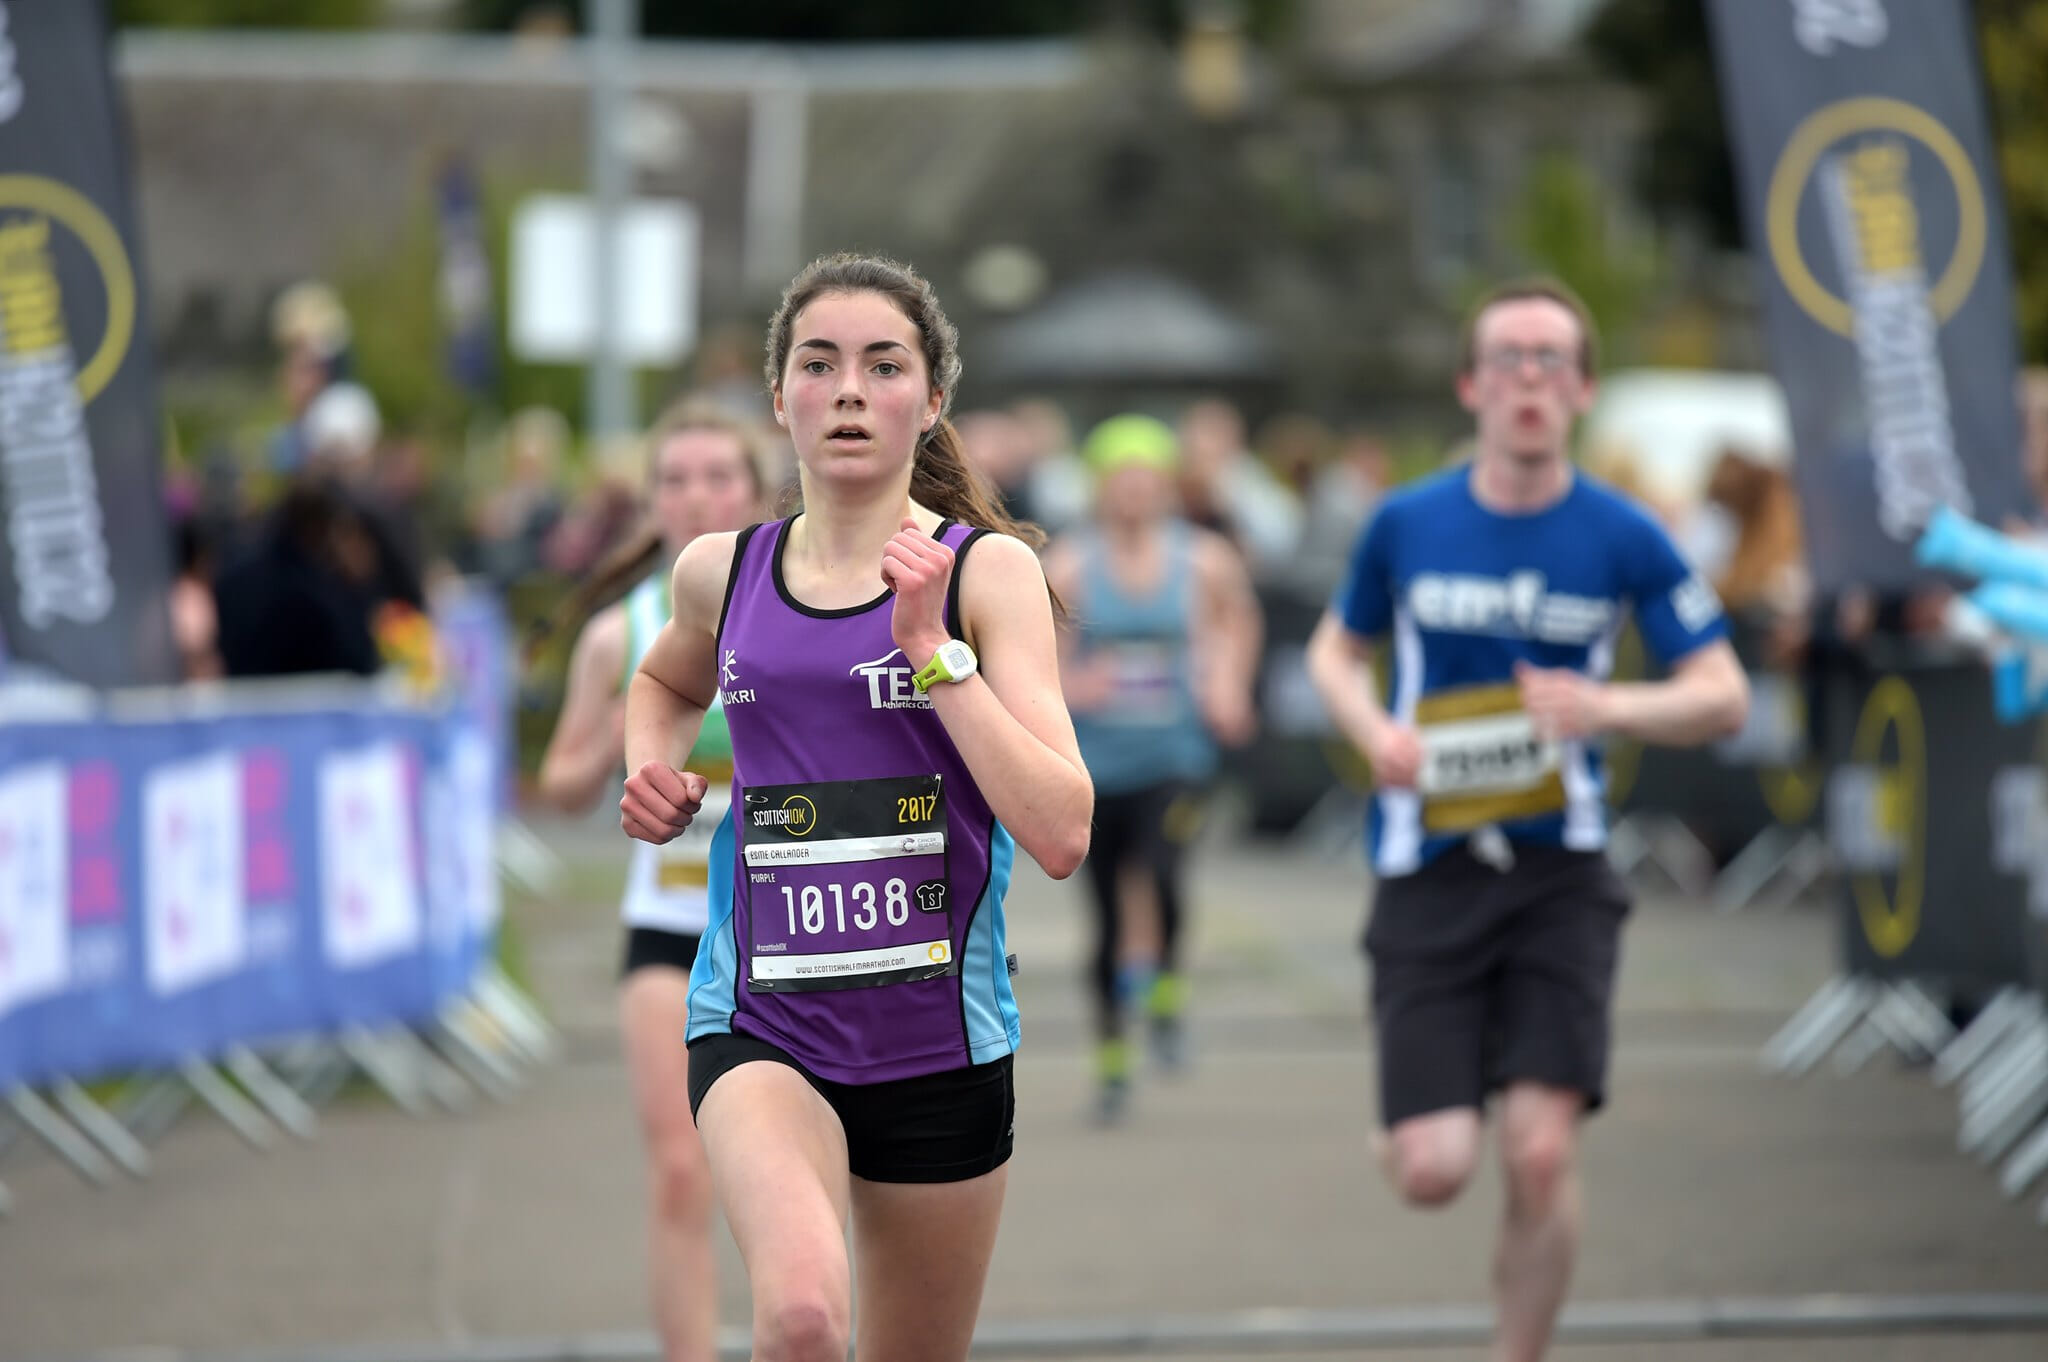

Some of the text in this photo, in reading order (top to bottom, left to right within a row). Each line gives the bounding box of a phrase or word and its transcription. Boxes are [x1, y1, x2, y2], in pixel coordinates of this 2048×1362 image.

[883, 701, 916, 709] Athletics
[753, 807, 806, 827] SCOTTISH10K
[897, 796, 936, 823] 2017
[750, 848, 810, 860] ESME CALLANDER
[751, 873, 776, 883] PURPLE
[781, 878, 909, 935] 10138
[928, 892, 936, 907] S
